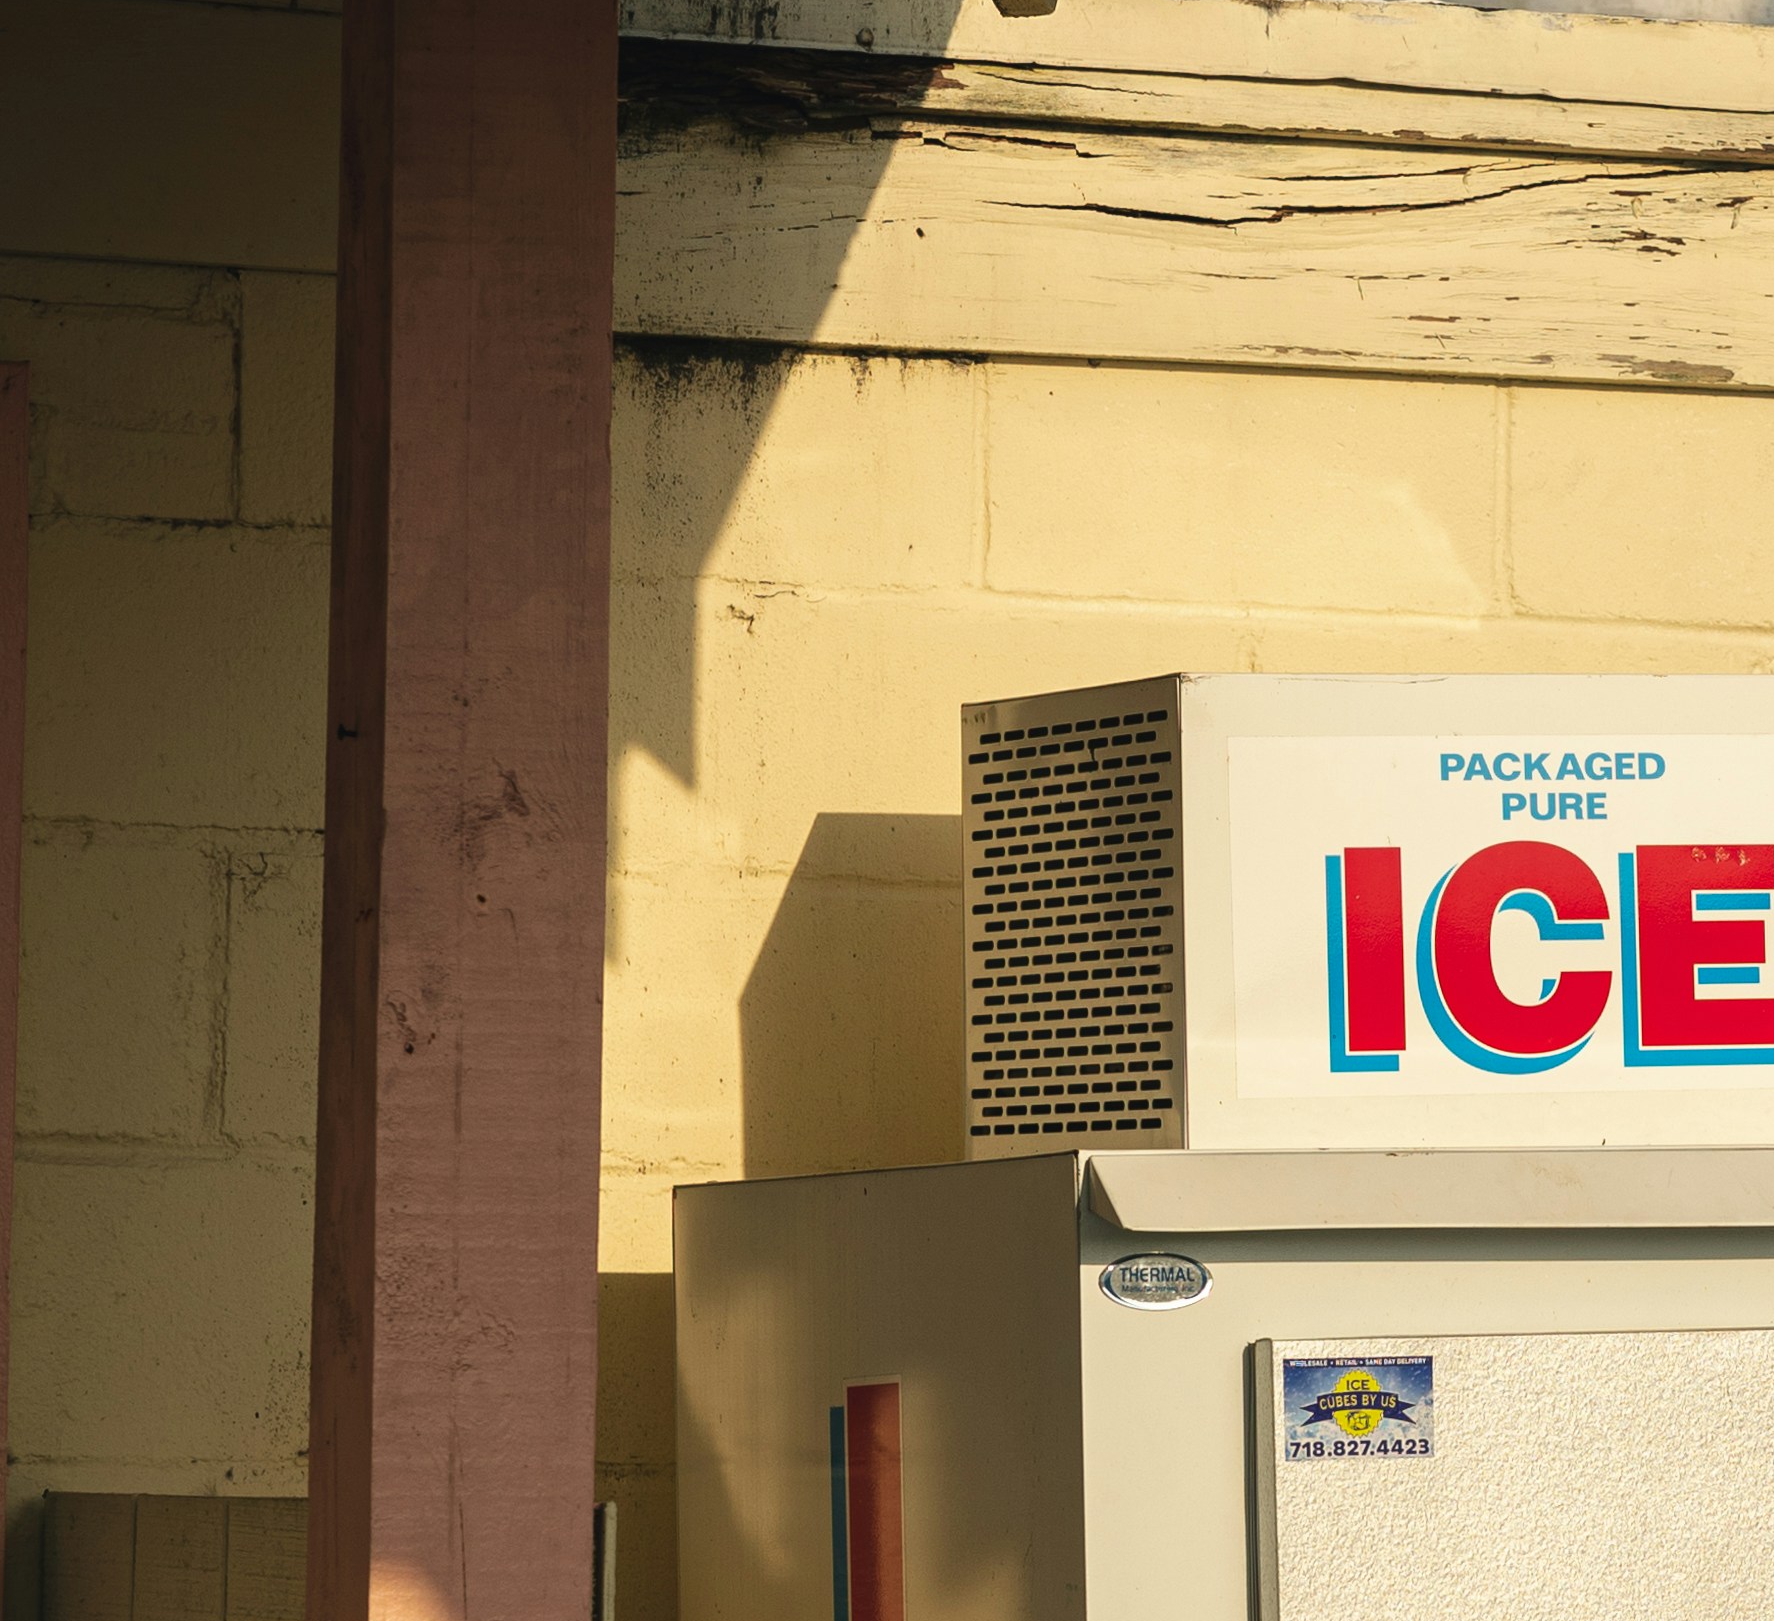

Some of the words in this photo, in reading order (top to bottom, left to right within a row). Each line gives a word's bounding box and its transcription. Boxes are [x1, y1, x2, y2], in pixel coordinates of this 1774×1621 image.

[1440, 753, 1666, 780] PACKAGED
[1502, 792, 1608, 820] PURE
[1120, 1267, 1195, 1282] THERMAL
[1346, 1380, 1370, 1390] ICE
[1319, 1395, 1357, 1410] CUBES
[1361, 1394, 1378, 1406] BY
[1381, 1395, 1397, 1408] US
[1290, 1439, 1430, 1458] 718.827.4423
